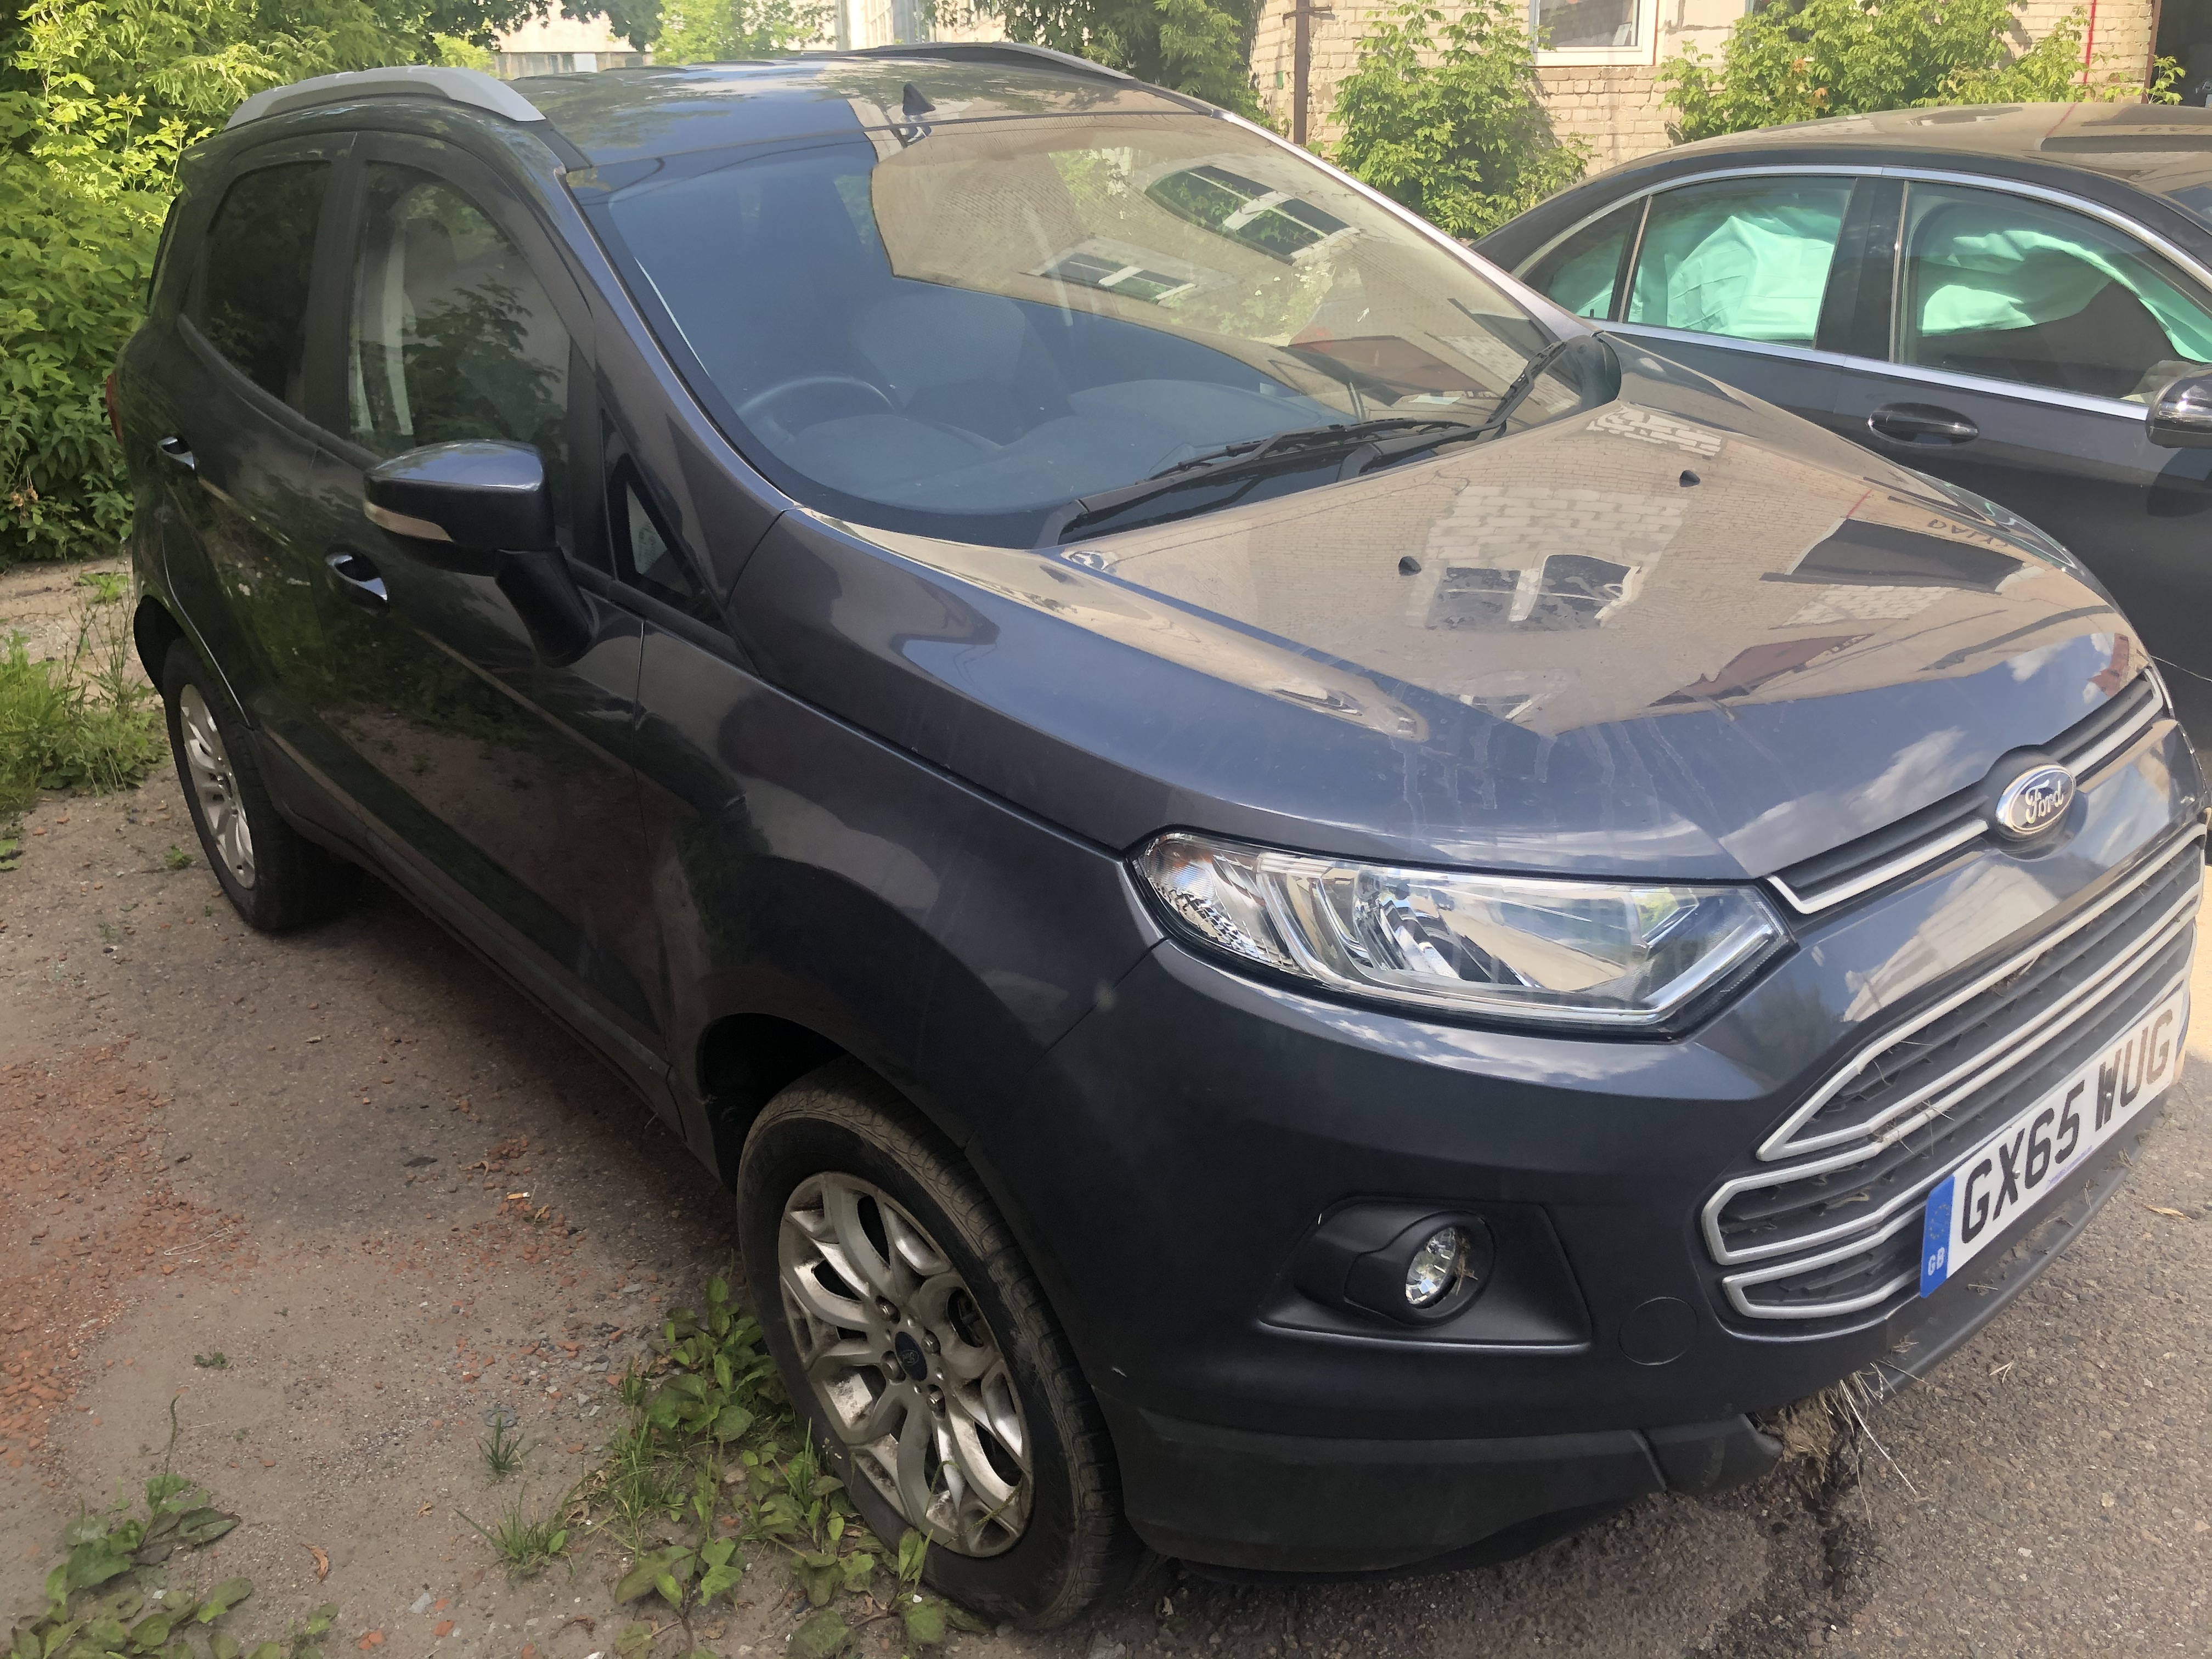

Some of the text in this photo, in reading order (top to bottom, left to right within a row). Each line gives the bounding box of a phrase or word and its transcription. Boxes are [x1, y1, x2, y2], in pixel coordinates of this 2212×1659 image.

[2025, 780, 2064, 824] Ford
[1962, 1009, 2172, 1243] GX65 WUG
[1928, 1246, 1945, 1276] GB
